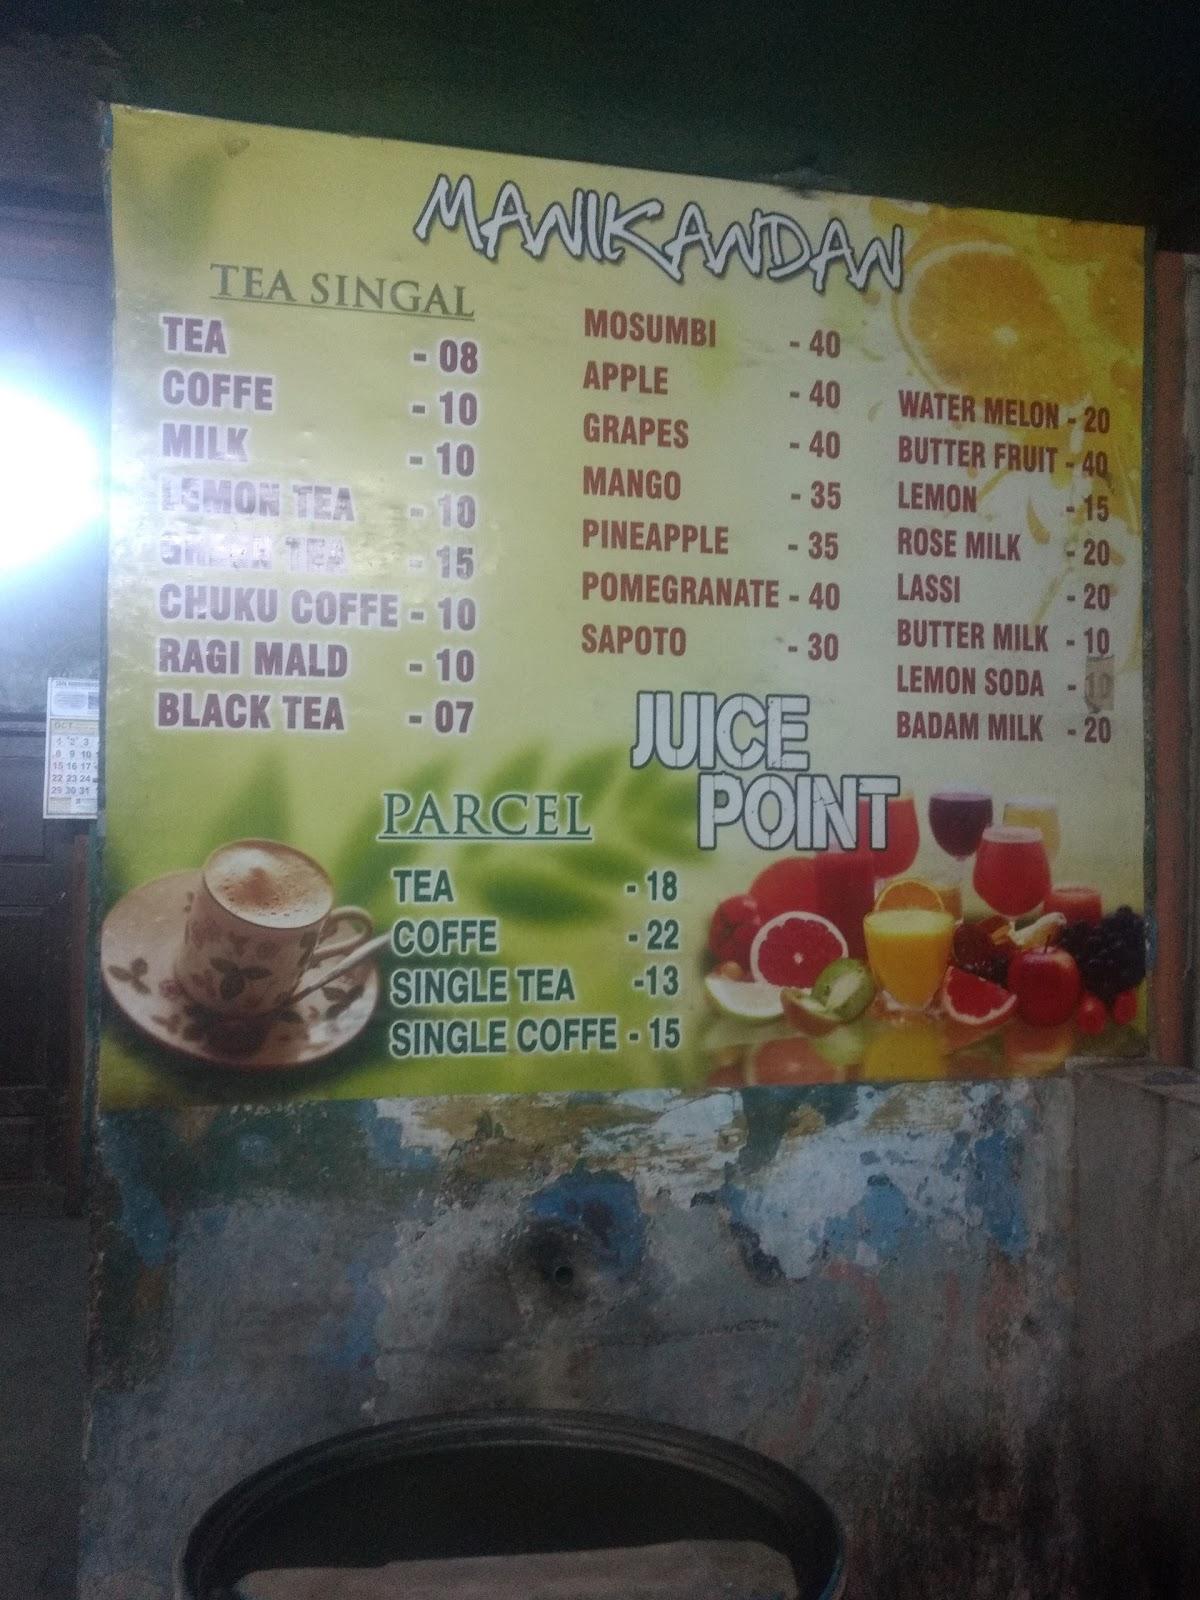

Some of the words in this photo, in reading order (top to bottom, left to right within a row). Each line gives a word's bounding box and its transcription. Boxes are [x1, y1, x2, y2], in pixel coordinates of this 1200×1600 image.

[413, 173, 904, 293] MANIKANDAN
[210, 264, 297, 302] TEA
[311, 273, 474, 318] SINGAL
[162, 316, 226, 353] TEA
[440, 340, 478, 374] 08
[584, 308, 716, 348] MOSUMBI
[809, 329, 841, 358] 40
[162, 370, 273, 411] COFFE
[439, 392, 477, 425] 10
[583, 361, 668, 395] APPLE
[809, 380, 841, 408] 40
[898, 389, 976, 422] WATER
[984, 397, 1059, 429] MELON
[1083, 406, 1110, 434] 20
[162, 423, 248, 460] MILK
[437, 443, 474, 476] 10
[583, 413, 689, 449] GRAPES
[809, 430, 841, 459] 40
[898, 435, 986, 469] BUTTER
[994, 442, 1058, 474] FRUIT
[1082, 450, 1108, 478] 40
[162, 478, 280, 517] LEMON
[292, 484, 354, 521] TEA
[438, 495, 475, 528] 10
[583, 465, 681, 501] MANGO
[811, 480, 841, 509] 35
[898, 481, 977, 513] LEMON
[1083, 494, 1109, 522] 15
[583, 518, 728, 554] PINEAPPLE
[808, 531, 839, 560] 35
[898, 527, 957, 557] ROSE
[965, 531, 1021, 561] MILK
[1083, 538, 1110, 566] 20
[437, 547, 474, 580] 15
[159, 584, 278, 623] CHUKU
[291, 589, 398, 627] COFFE
[438, 598, 476, 631] 10
[582, 571, 779, 608] POMEGRANATE
[808, 582, 840, 611] 40
[897, 573, 960, 603] LASSI
[1083, 582, 1111, 610] 20
[581, 623, 687, 657] SAPOTO
[808, 632, 839, 661] 30
[897, 619, 985, 649] BUTTER
[993, 623, 1049, 652] MILK
[1083, 627, 1110, 655] 10
[159, 638, 240, 675] RAGI
[255, 641, 348, 677] MALD
[437, 649, 474, 682] 10
[897, 665, 976, 695] LEMON
[984, 668, 1044, 697] SODA
[158, 693, 271, 729] BLACK
[283, 696, 345, 730] TEA
[435, 700, 474, 733] 07
[630, 690, 810, 771] JUICE
[896, 711, 979, 740] BADAM
[988, 714, 1044, 742] MILK
[1084, 716, 1112, 743] 20
[383, 793, 591, 836] PARCEL
[697, 771, 900, 850] POINT
[393, 870, 454, 902] TEA
[647, 870, 678, 901] 18
[393, 920, 497, 953] COFFE
[647, 920, 679, 950] 22
[392, 969, 507, 1005] SINGLE
[517, 968, 576, 1001] TEA
[391, 1020, 507, 1056] SINGLE
[516, 1018, 617, 1051] COFFE
[649, 1017, 681, 1048] 15
